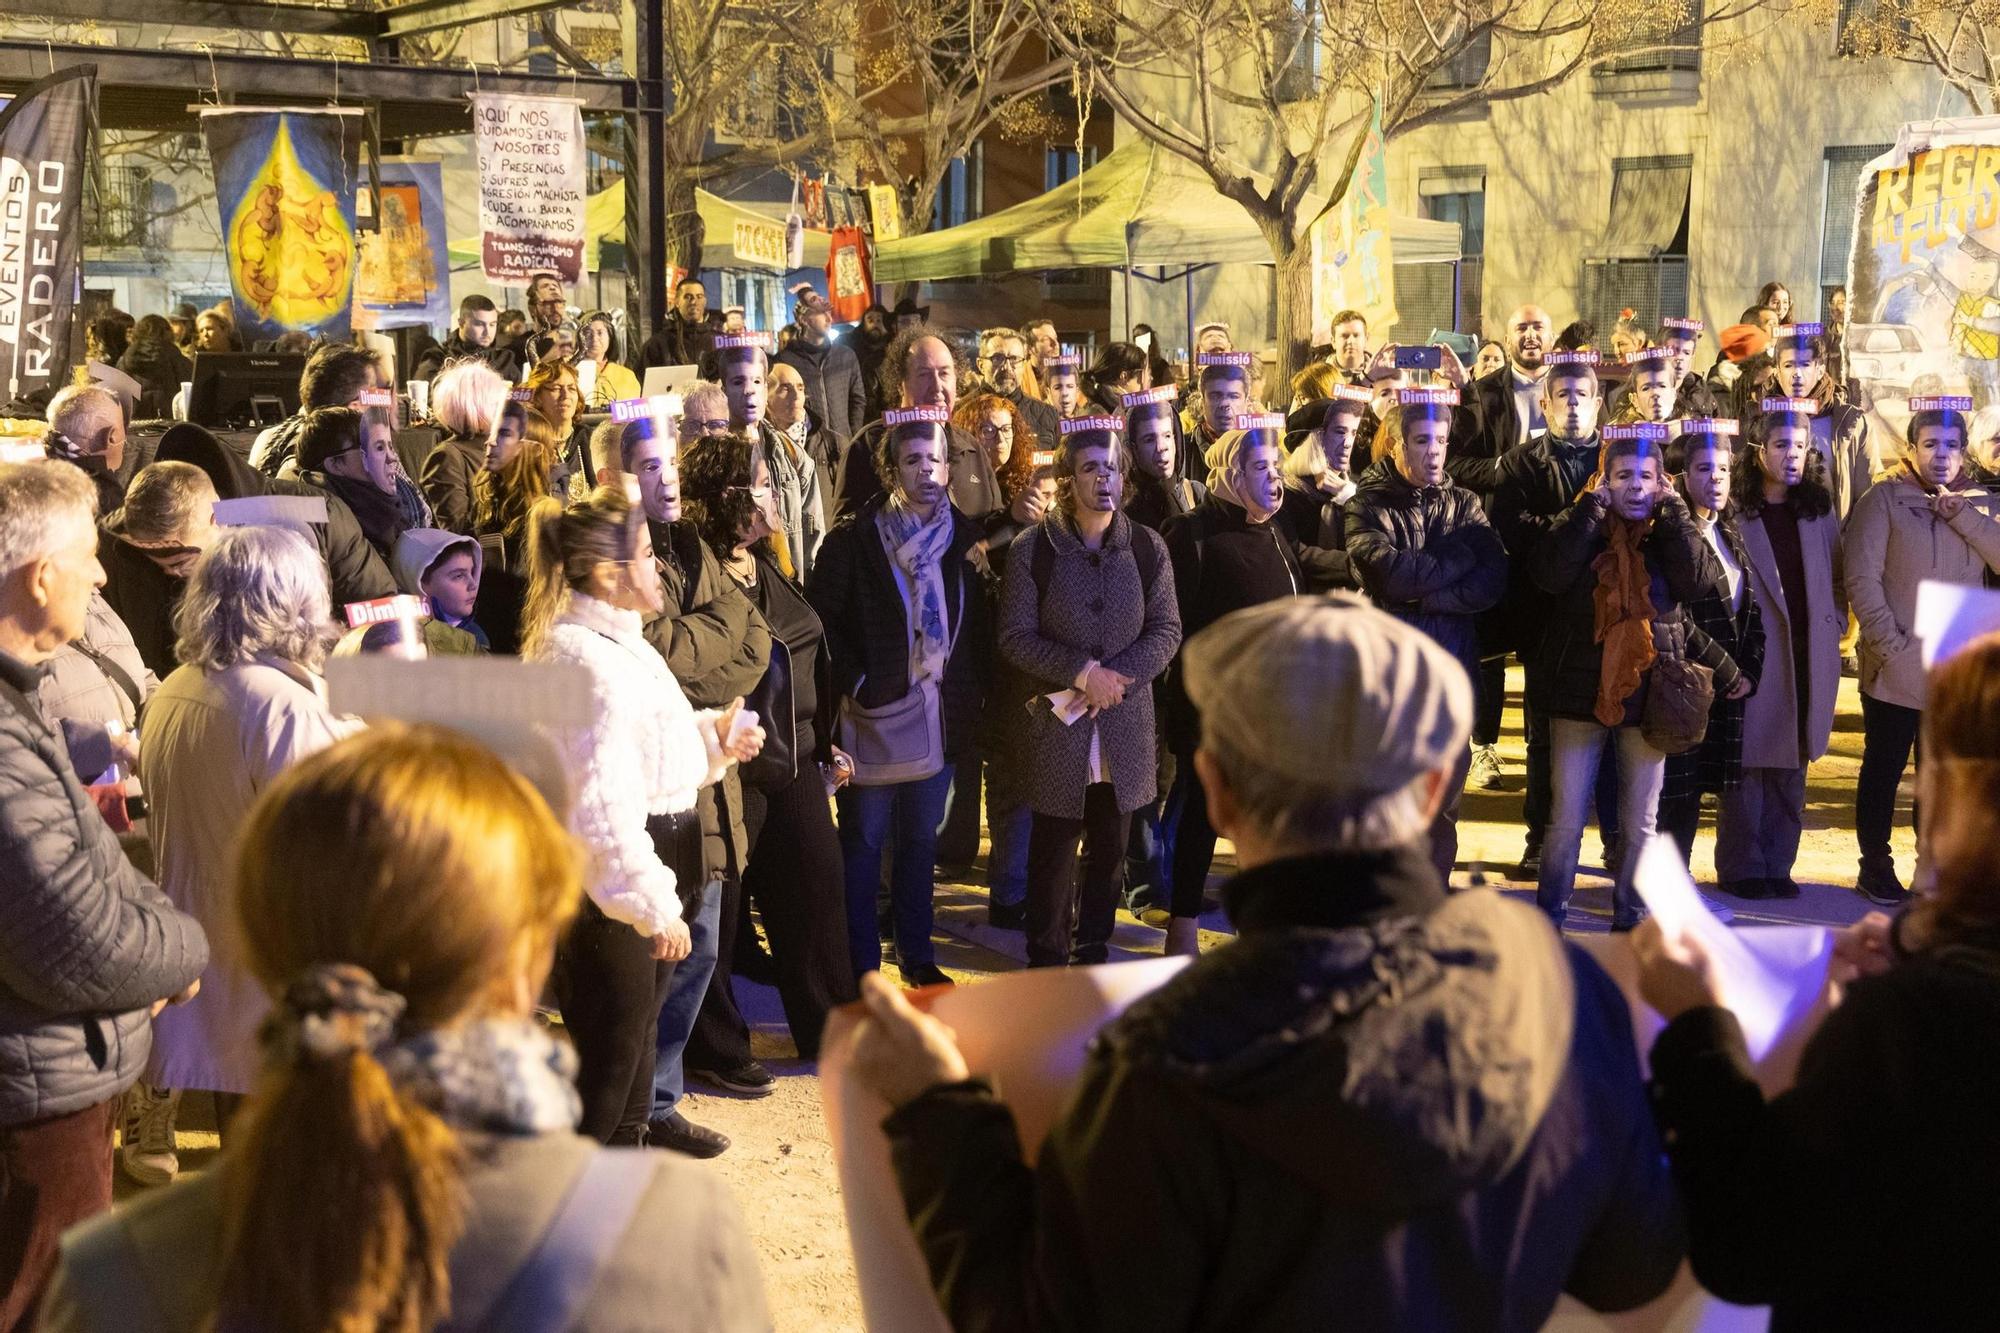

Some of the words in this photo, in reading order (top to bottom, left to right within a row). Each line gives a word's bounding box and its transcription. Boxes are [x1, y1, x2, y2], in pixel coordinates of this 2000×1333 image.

[520, 111, 549, 127] NOS
[538, 130, 568, 142] ENTRE
[493, 142, 560, 156] NOSOTRES
[501, 159, 566, 175] PRESENCIAS
[490, 174, 529, 187] SUFRES
[533, 187, 580, 201] MACHISTA
[518, 205, 524, 213] A
[496, 215, 575, 232] ACOMPAÑAMOS
[0, 173, 24, 325] EVENTOS
[491, 241, 574, 258] TRANSFEMINISMO
[504, 254, 559, 269] RADICAL
[1663, 317, 1703, 331] Dimissió
[1773, 324, 1821, 337] Dimissió
[715, 332, 770, 349] Dimissió
[1198, 353, 1250, 365] Dimissió
[1544, 351, 1598, 365] Dimissió
[1625, 346, 1675, 363] Dimissió
[1400, 387, 1458, 404] Dimissió
[1911, 397, 1970, 410] Dimissió
[885, 406, 949, 425] Dimissió
[1060, 416, 1123, 434] Dimissió
[1603, 424, 1666, 439] Dimissió
